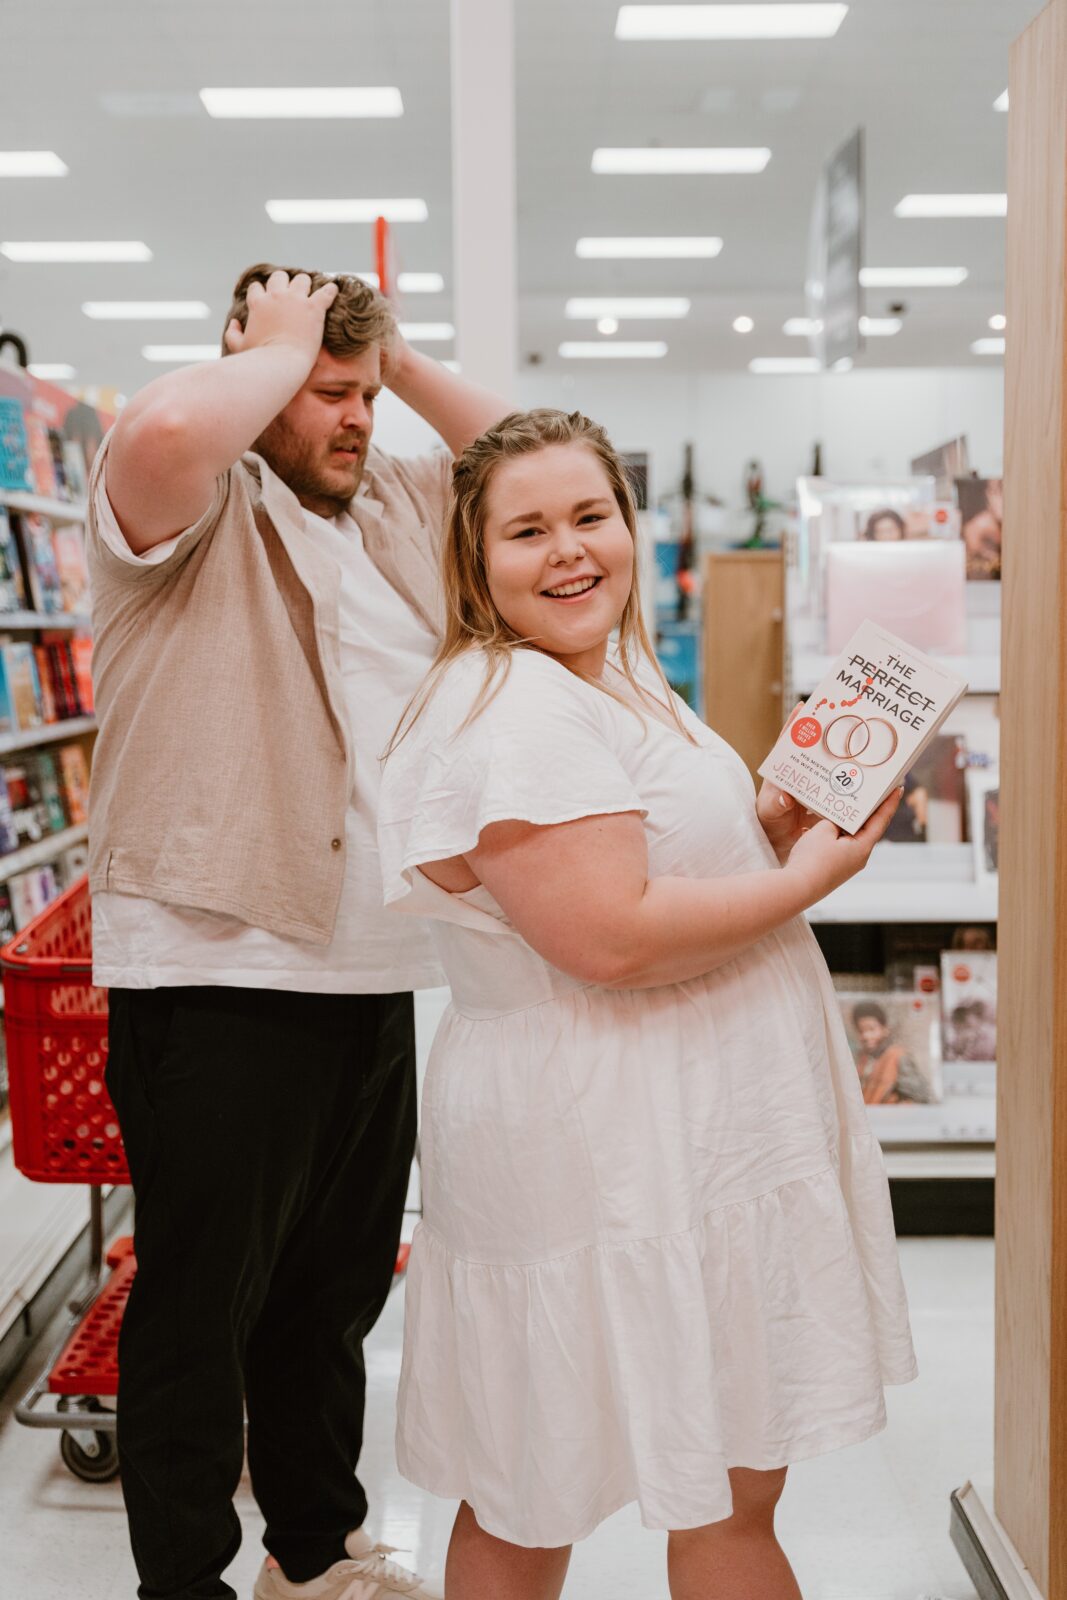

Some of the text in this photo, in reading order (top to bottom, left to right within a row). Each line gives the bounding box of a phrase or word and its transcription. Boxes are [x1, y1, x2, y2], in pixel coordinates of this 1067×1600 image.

[849, 654, 935, 711] PERFECT
[886, 655, 915, 679] THE
[836, 670, 925, 730] MARRIAGE
[773, 763, 820, 796] JENEVA
[823, 793, 859, 821] ROSE
